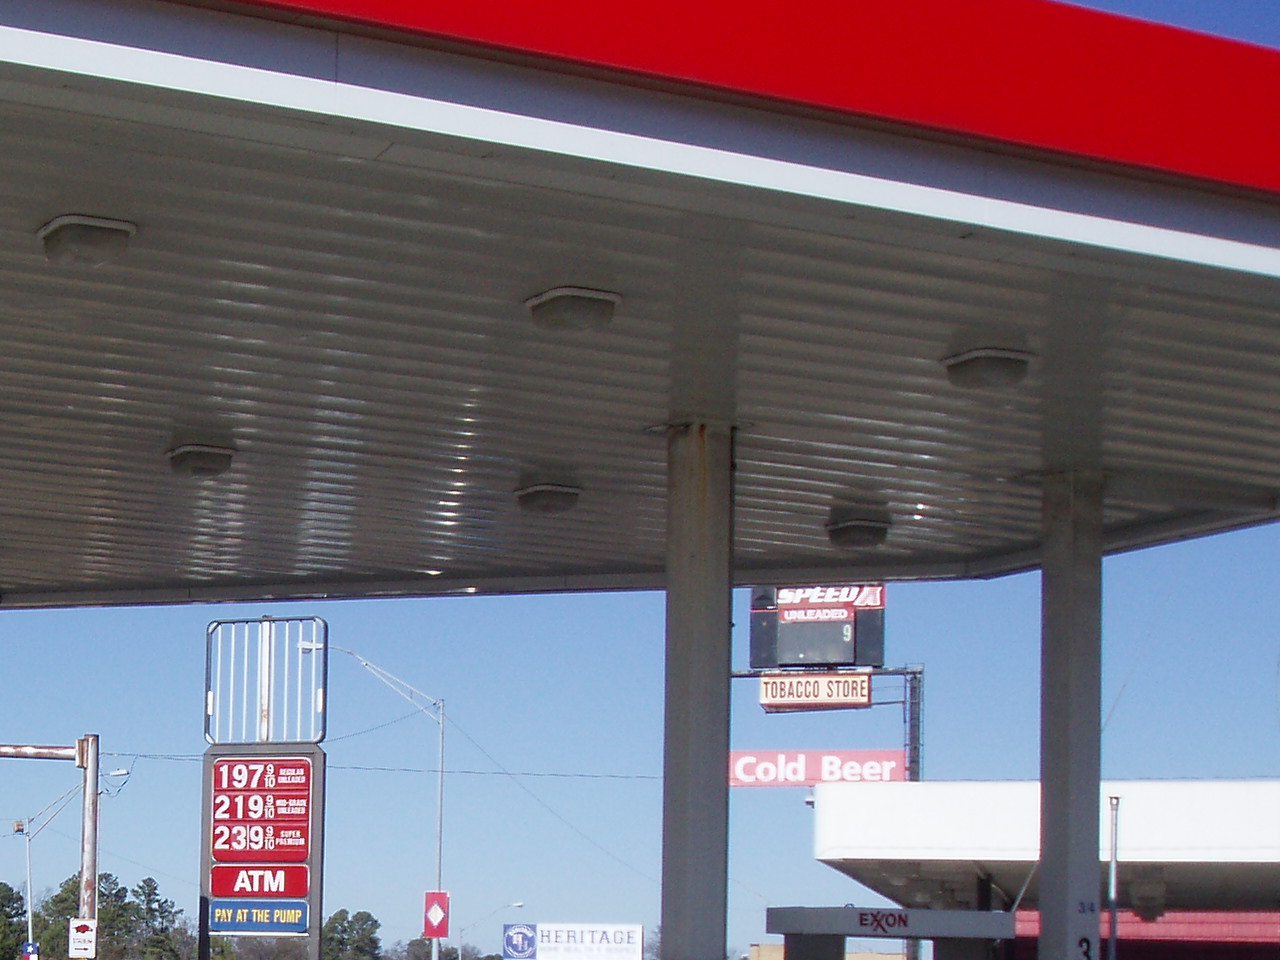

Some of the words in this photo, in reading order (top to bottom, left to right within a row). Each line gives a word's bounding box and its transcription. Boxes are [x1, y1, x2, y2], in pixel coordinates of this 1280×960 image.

[784, 609, 848, 620] UNLEADED
[843, 625, 851, 641] 9
[763, 680, 820, 699] TOBACCO
[827, 680, 867, 698] STORE
[735, 755, 806, 781] Cold
[821, 755, 896, 781] Beer
[233, 870, 286, 892] ATM
[214, 909, 232, 922] PAY
[235, 909, 249, 922] AT
[252, 909, 270, 922] THE
[273, 909, 303, 923] PUMP
[859, 911, 908, 933] EXXON
[539, 929, 637, 945] HERITAGE
